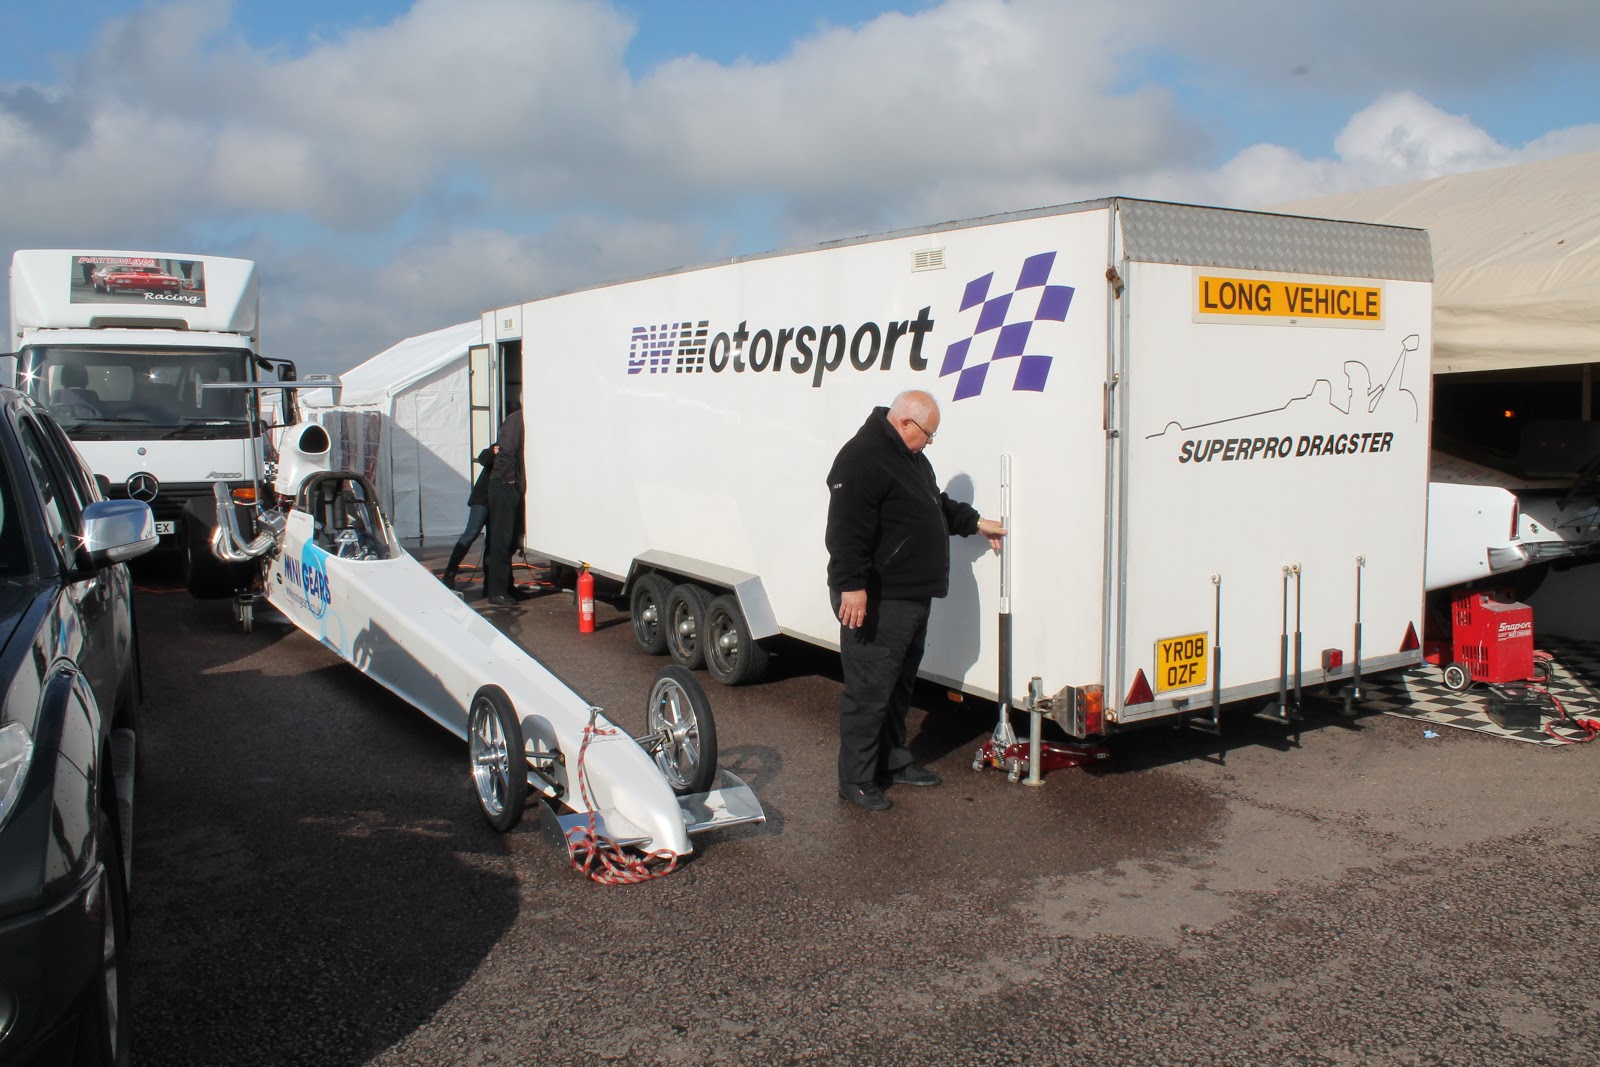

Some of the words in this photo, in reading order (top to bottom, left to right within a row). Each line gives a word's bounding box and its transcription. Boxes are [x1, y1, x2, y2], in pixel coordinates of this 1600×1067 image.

[78, 257, 155, 267] PATEMAN
[143, 292, 201, 305] Racing
[1203, 280, 1271, 312] LONG
[1285, 286, 1378, 317] VEHICLE
[1178, 436, 1293, 464] SUPERPRO
[1295, 432, 1394, 457] DRAGSTER
[302, 563, 331, 605] GEARS
[1162, 637, 1204, 663] YR08
